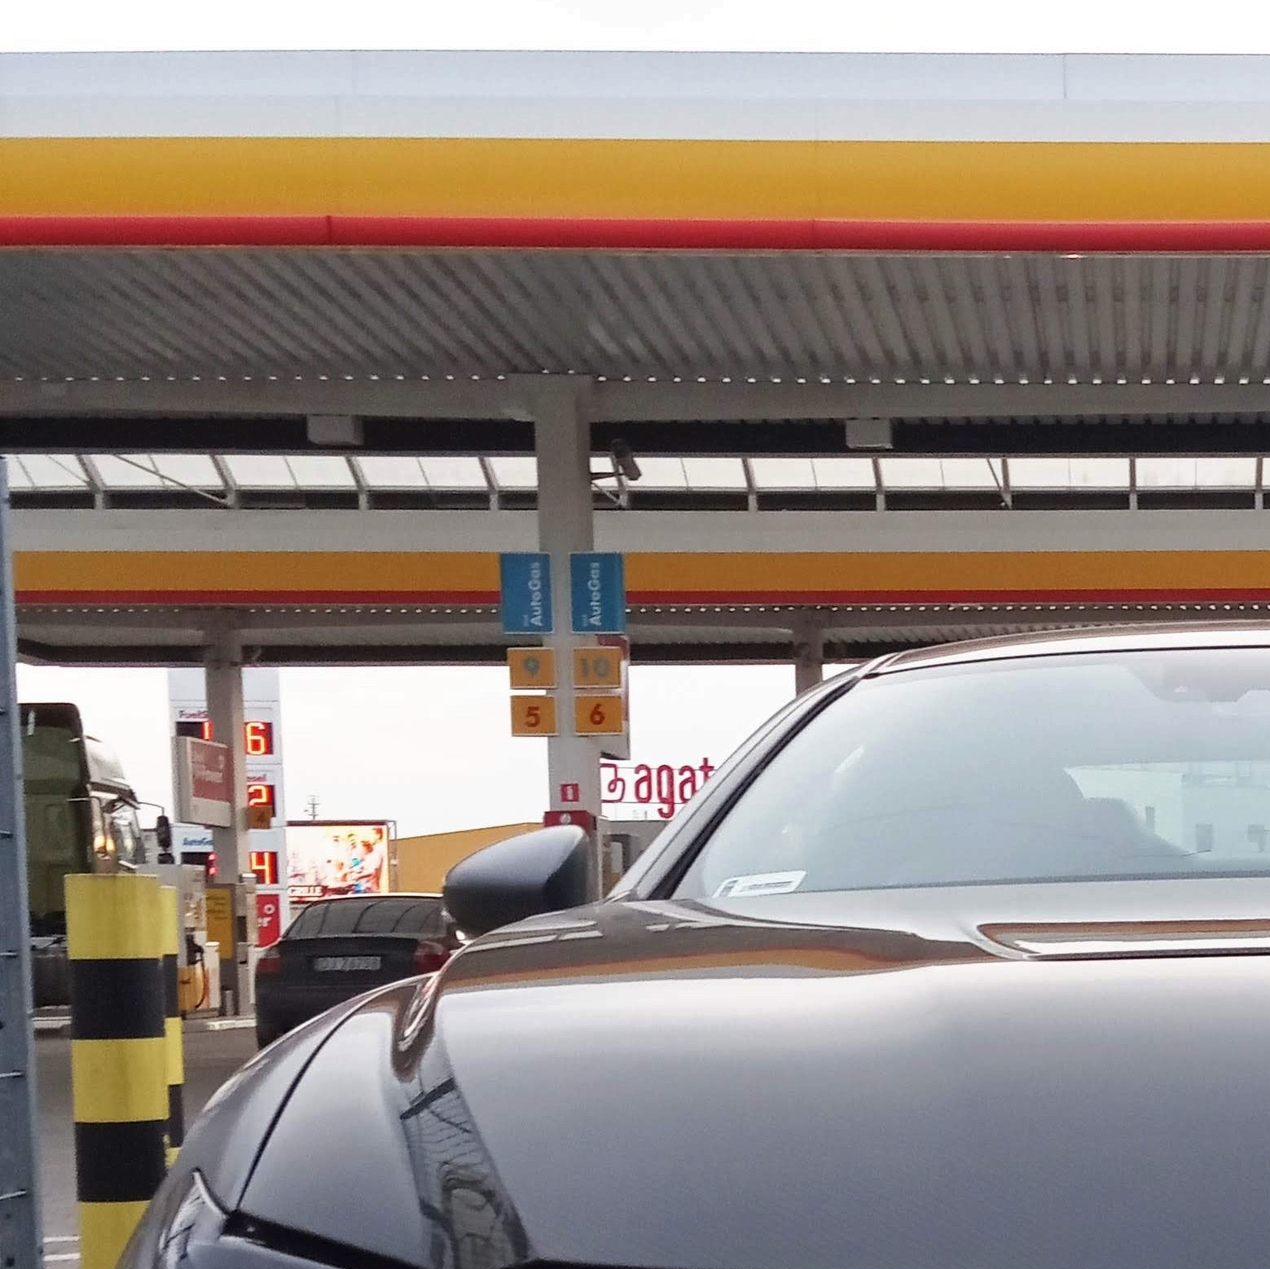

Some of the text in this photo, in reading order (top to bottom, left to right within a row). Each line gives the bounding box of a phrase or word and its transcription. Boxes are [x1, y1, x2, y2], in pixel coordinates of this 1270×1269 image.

[528, 562, 542, 627] AutoGas
[588, 562, 602, 626] AutoGas
[525, 706, 541, 728] 5
[589, 703, 606, 726] 6
[634, 757, 714, 819] agat
